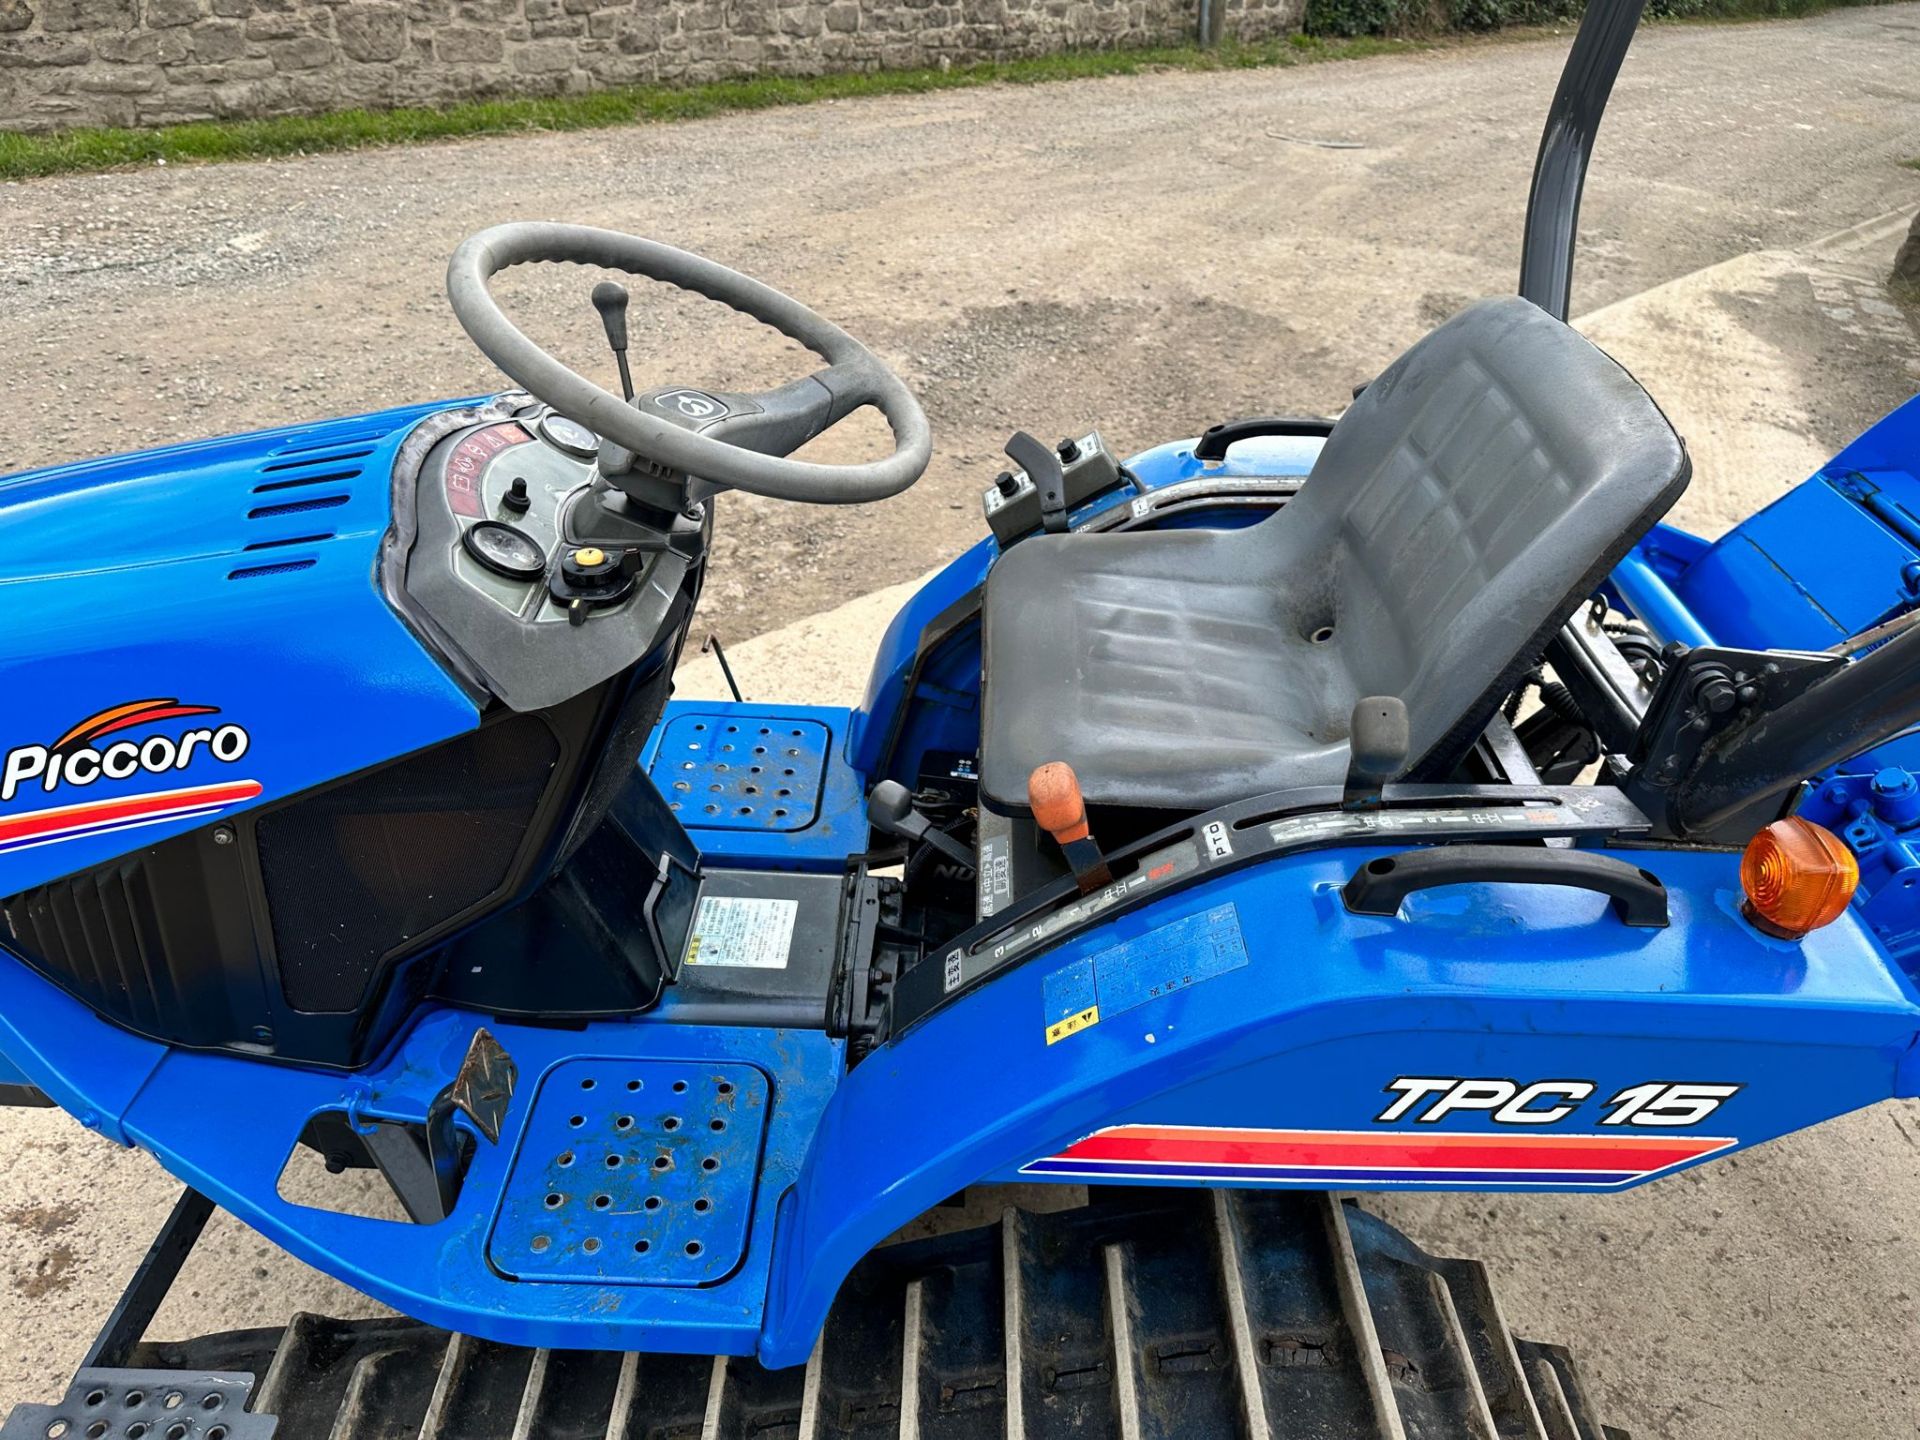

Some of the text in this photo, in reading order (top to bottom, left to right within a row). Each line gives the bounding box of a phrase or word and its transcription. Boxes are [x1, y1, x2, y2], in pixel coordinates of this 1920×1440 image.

[1, 724, 249, 800] Piccoro
[1210, 824, 1226, 856] PTO
[1032, 925, 1042, 937] 2
[994, 945, 1005, 958] 3
[1378, 1077, 1741, 1126] TPC 15
